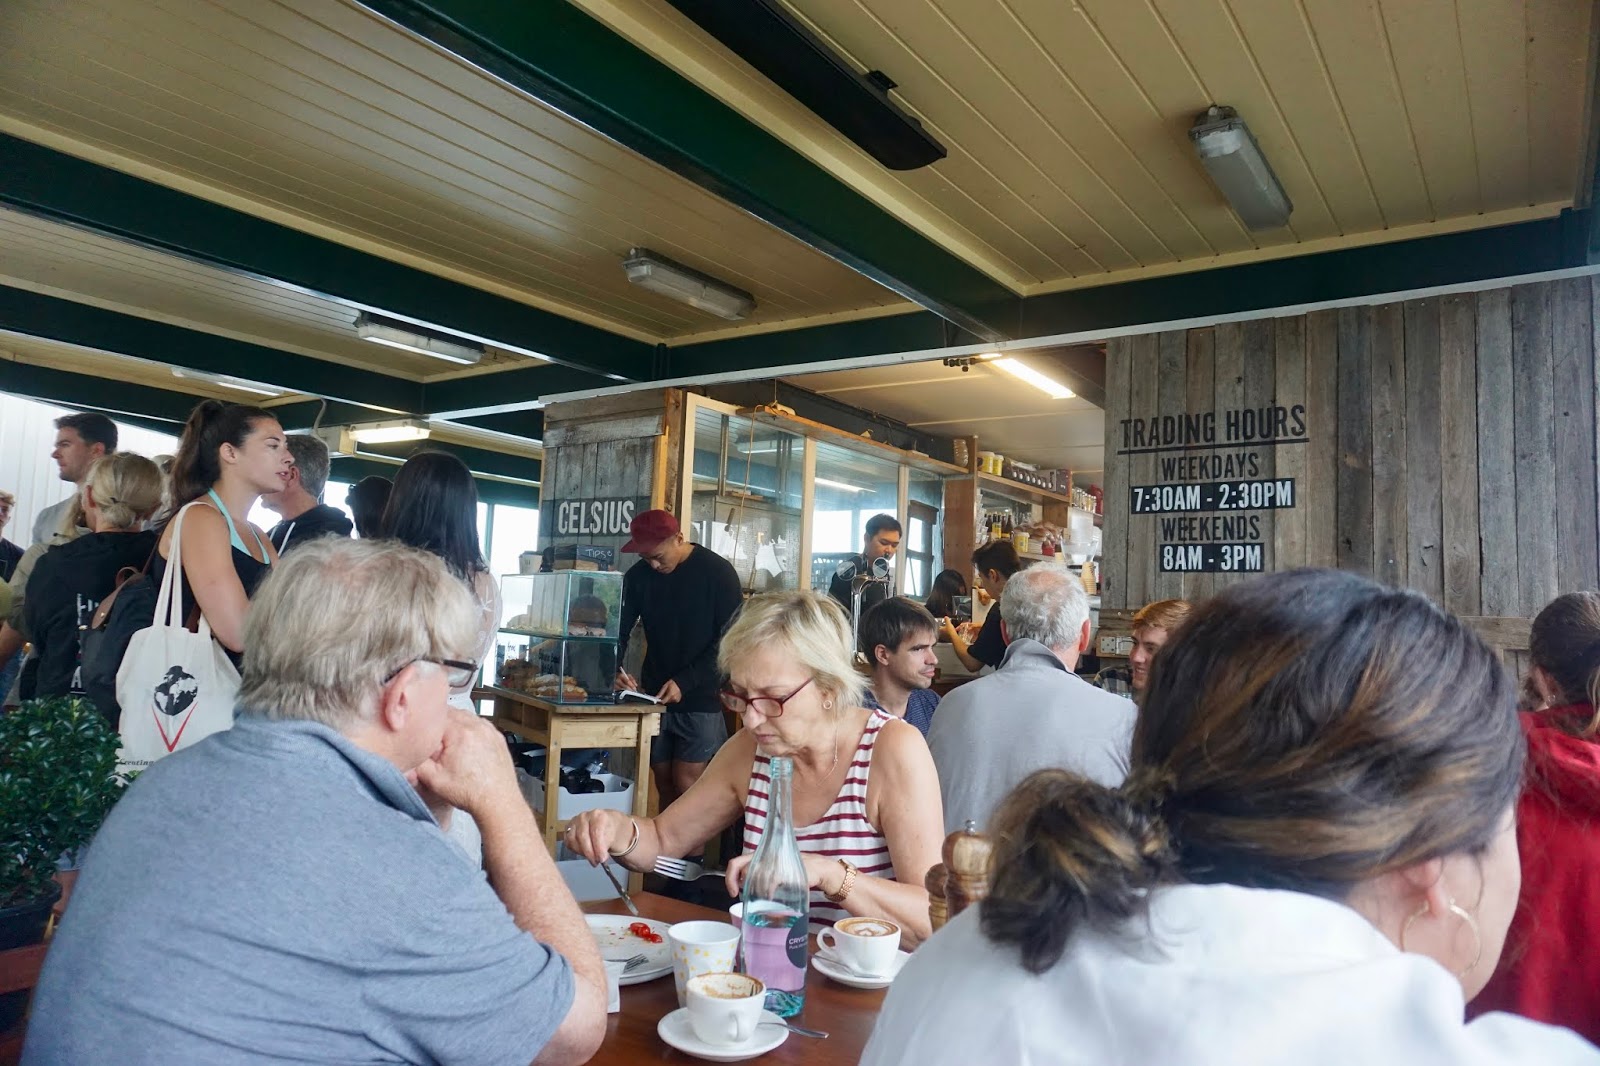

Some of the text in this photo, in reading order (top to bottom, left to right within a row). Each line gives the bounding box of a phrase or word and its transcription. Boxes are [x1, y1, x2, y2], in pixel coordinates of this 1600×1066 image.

[1119, 404, 1306, 448] TRADING HOURS
[1161, 452, 1260, 481] WEEKDAYS
[1133, 485, 1201, 512] 7:30AM
[1218, 480, 1292, 509] 2:30PM
[558, 500, 635, 534] CELSIUS
[1161, 515, 1261, 542] WEEKENDS
[585, 548, 607, 559] TIPS
[1163, 545, 1203, 570] 8AM
[1220, 545, 1261, 570] 3PM
